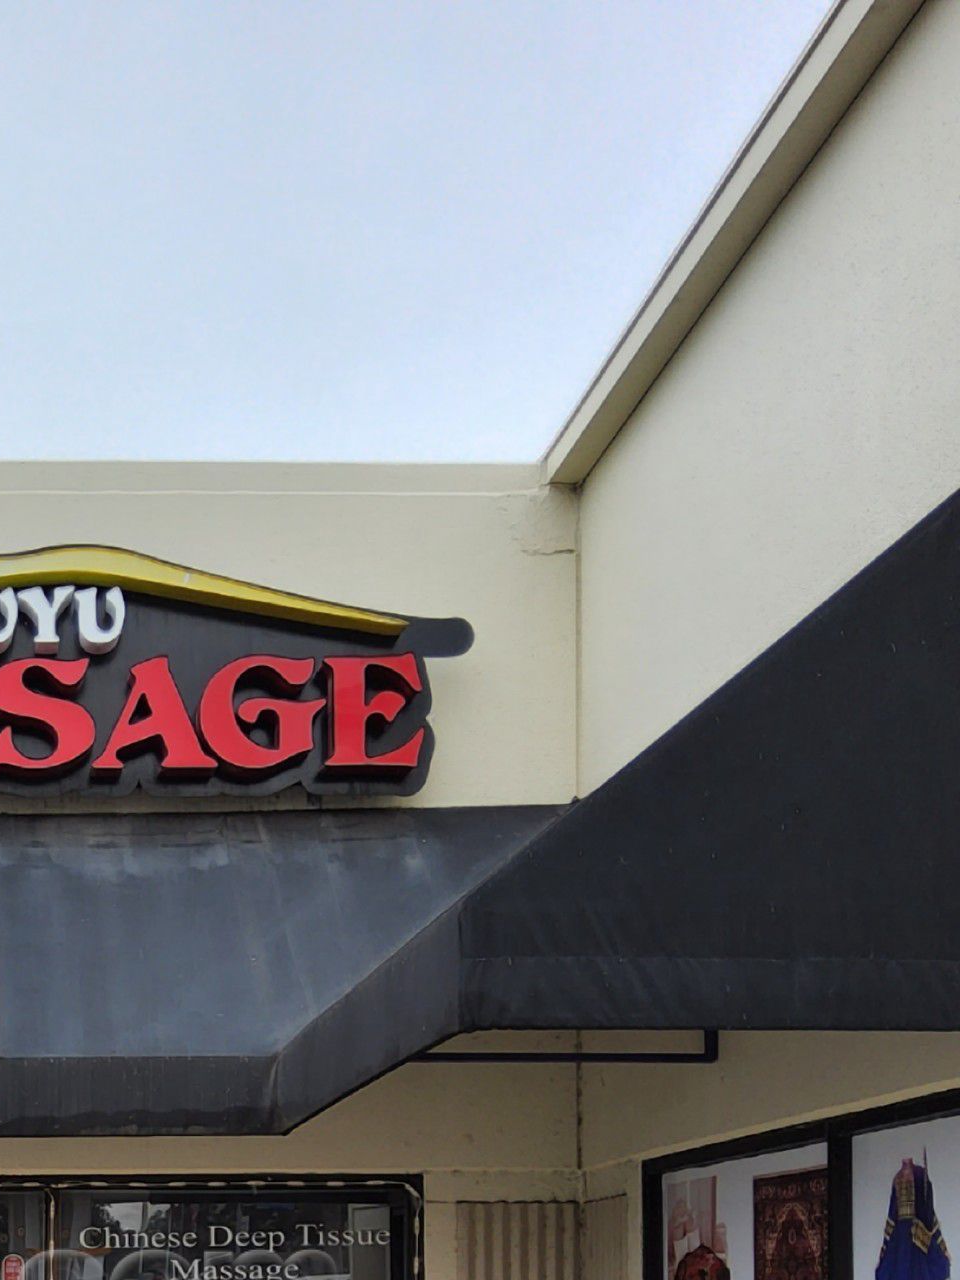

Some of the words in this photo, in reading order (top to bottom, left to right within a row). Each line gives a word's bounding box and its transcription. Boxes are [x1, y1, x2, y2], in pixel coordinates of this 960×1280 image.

[79, 1225, 198, 1249] Chinese
[209, 1225, 285, 1251] Deep
[296, 1223, 391, 1248] Tissue
